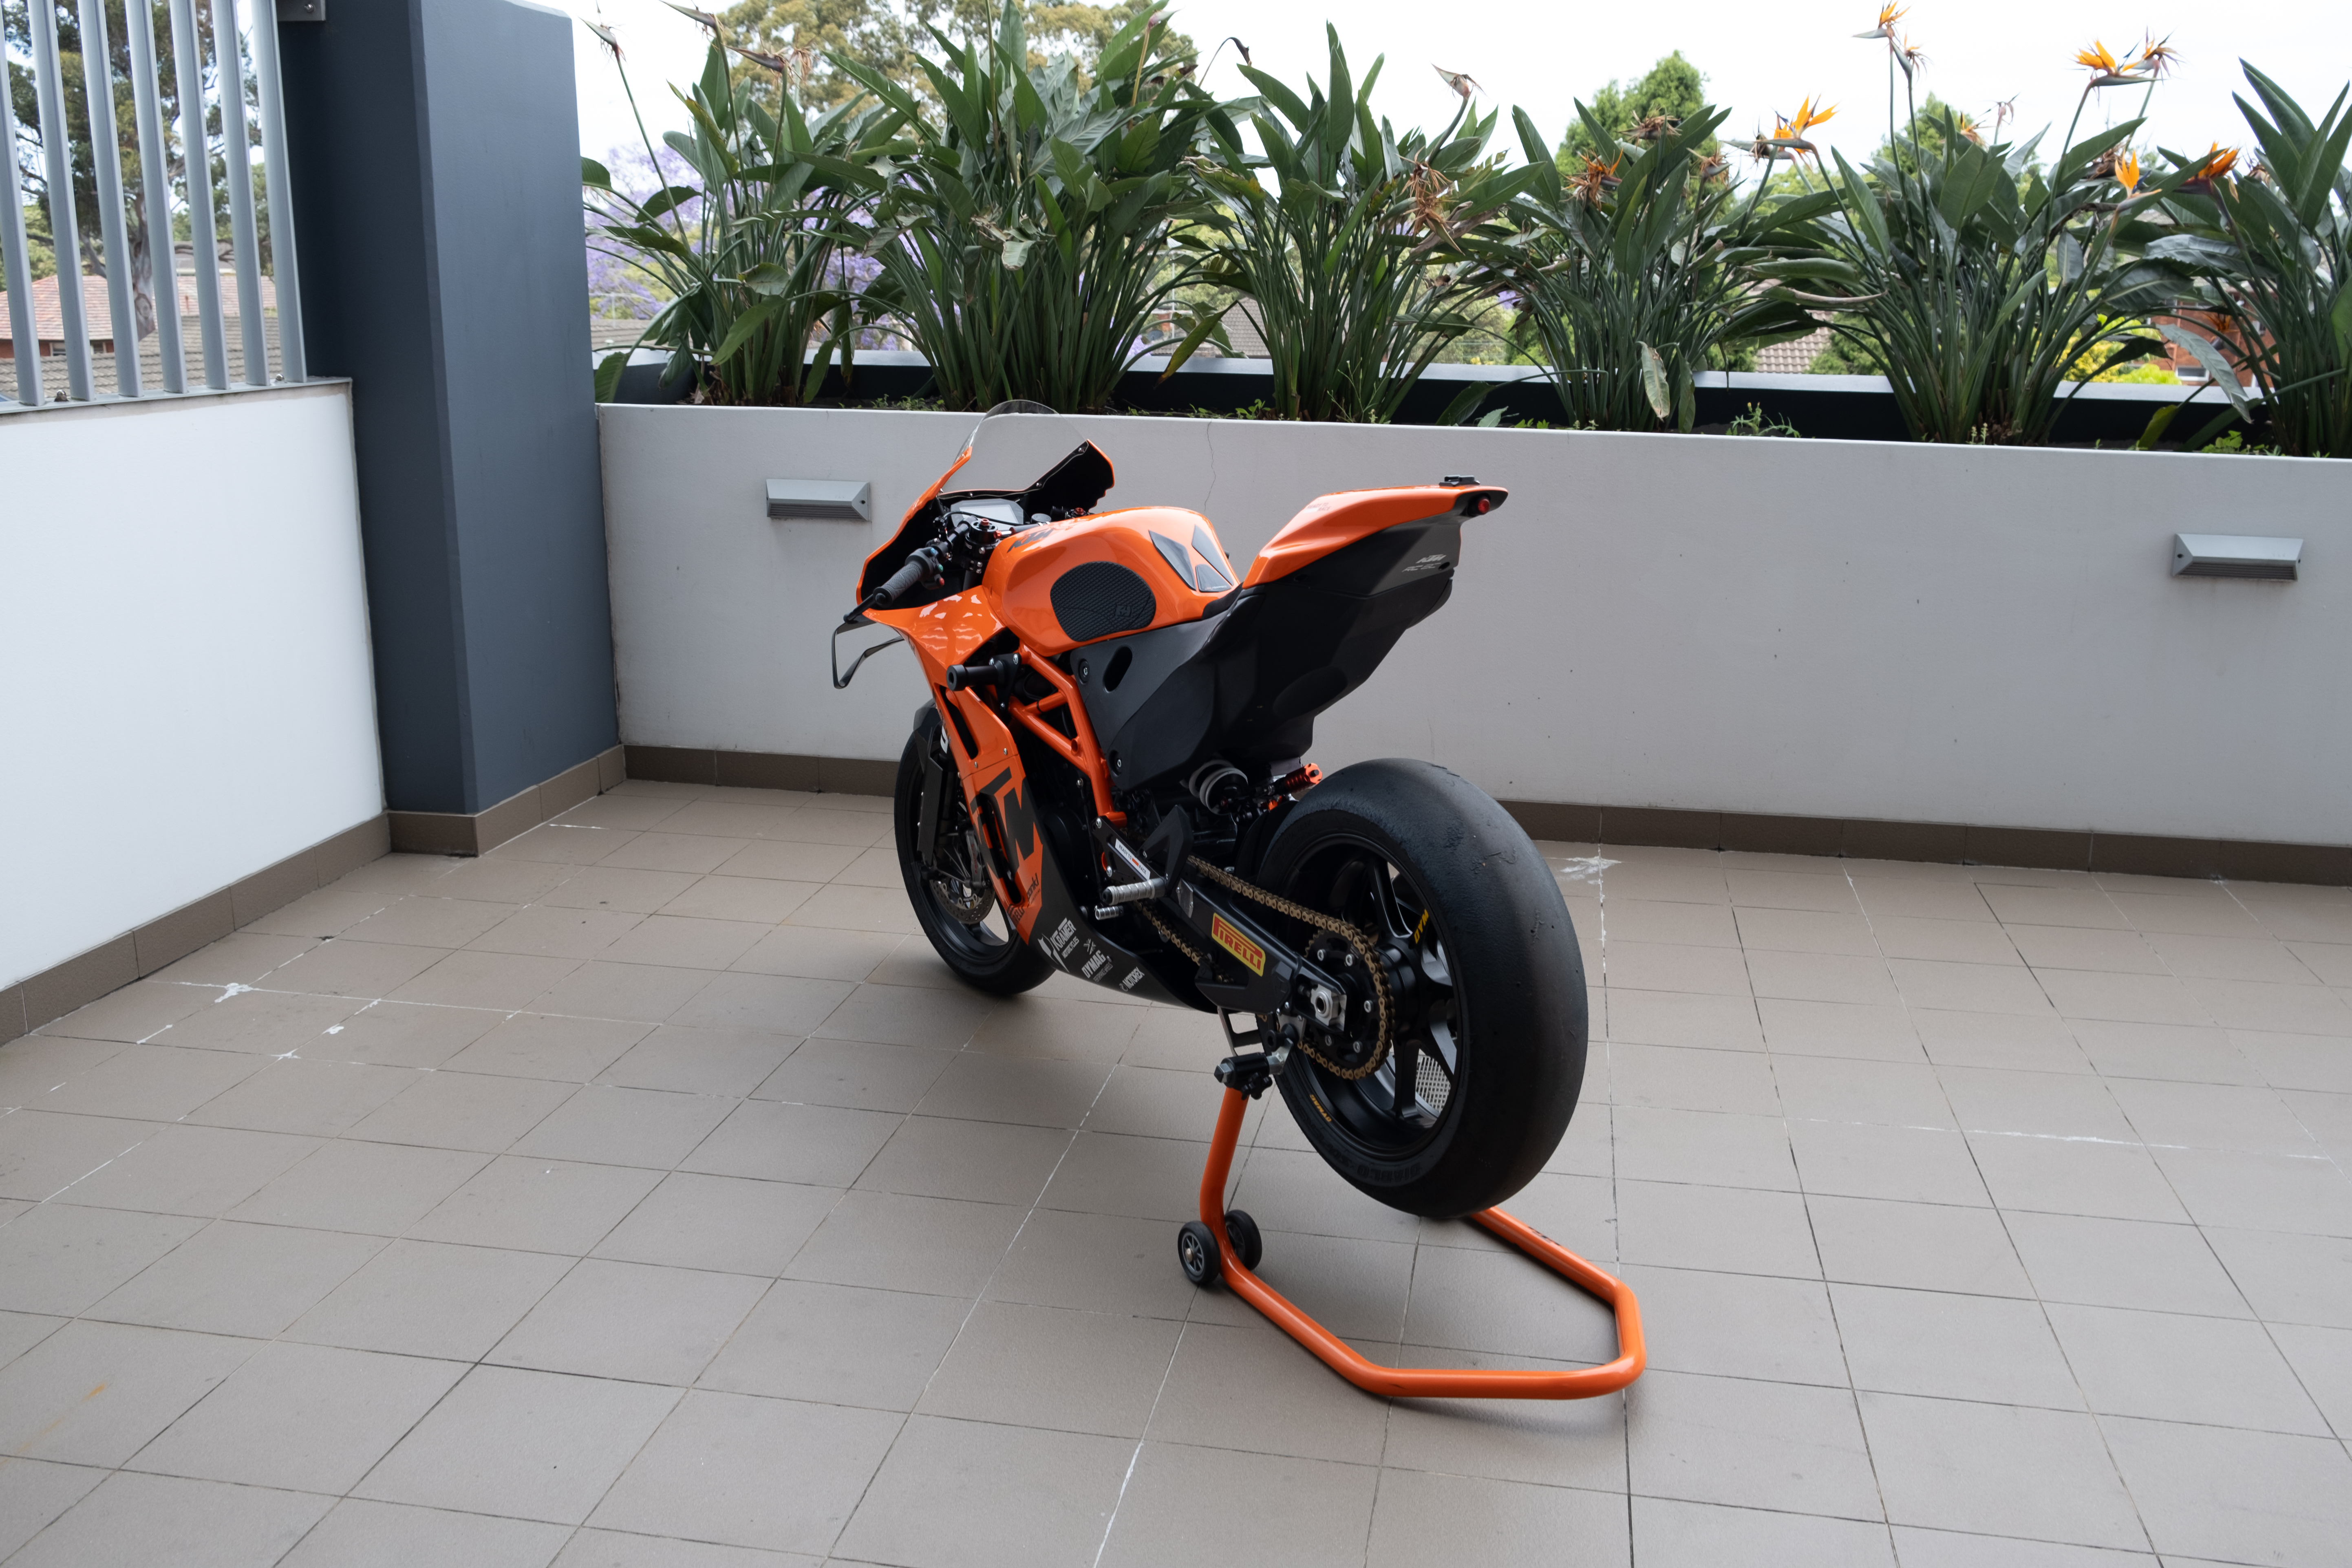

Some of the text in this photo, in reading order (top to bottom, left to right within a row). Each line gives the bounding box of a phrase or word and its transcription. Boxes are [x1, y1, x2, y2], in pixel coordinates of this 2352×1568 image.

[1416, 554, 1447, 563] KTM
[1119, 844, 1128, 856] READY
[1061, 936, 1079, 959] MOTORCYCLES
[1213, 916, 1263, 970] PIRELLI
[1081, 950, 1106, 978] DYMAG
[1122, 966, 1145, 989] MOTOREX
[1310, 1094, 1332, 1122] DYMAG
[1357, 1162, 1421, 1184] DIABLO
